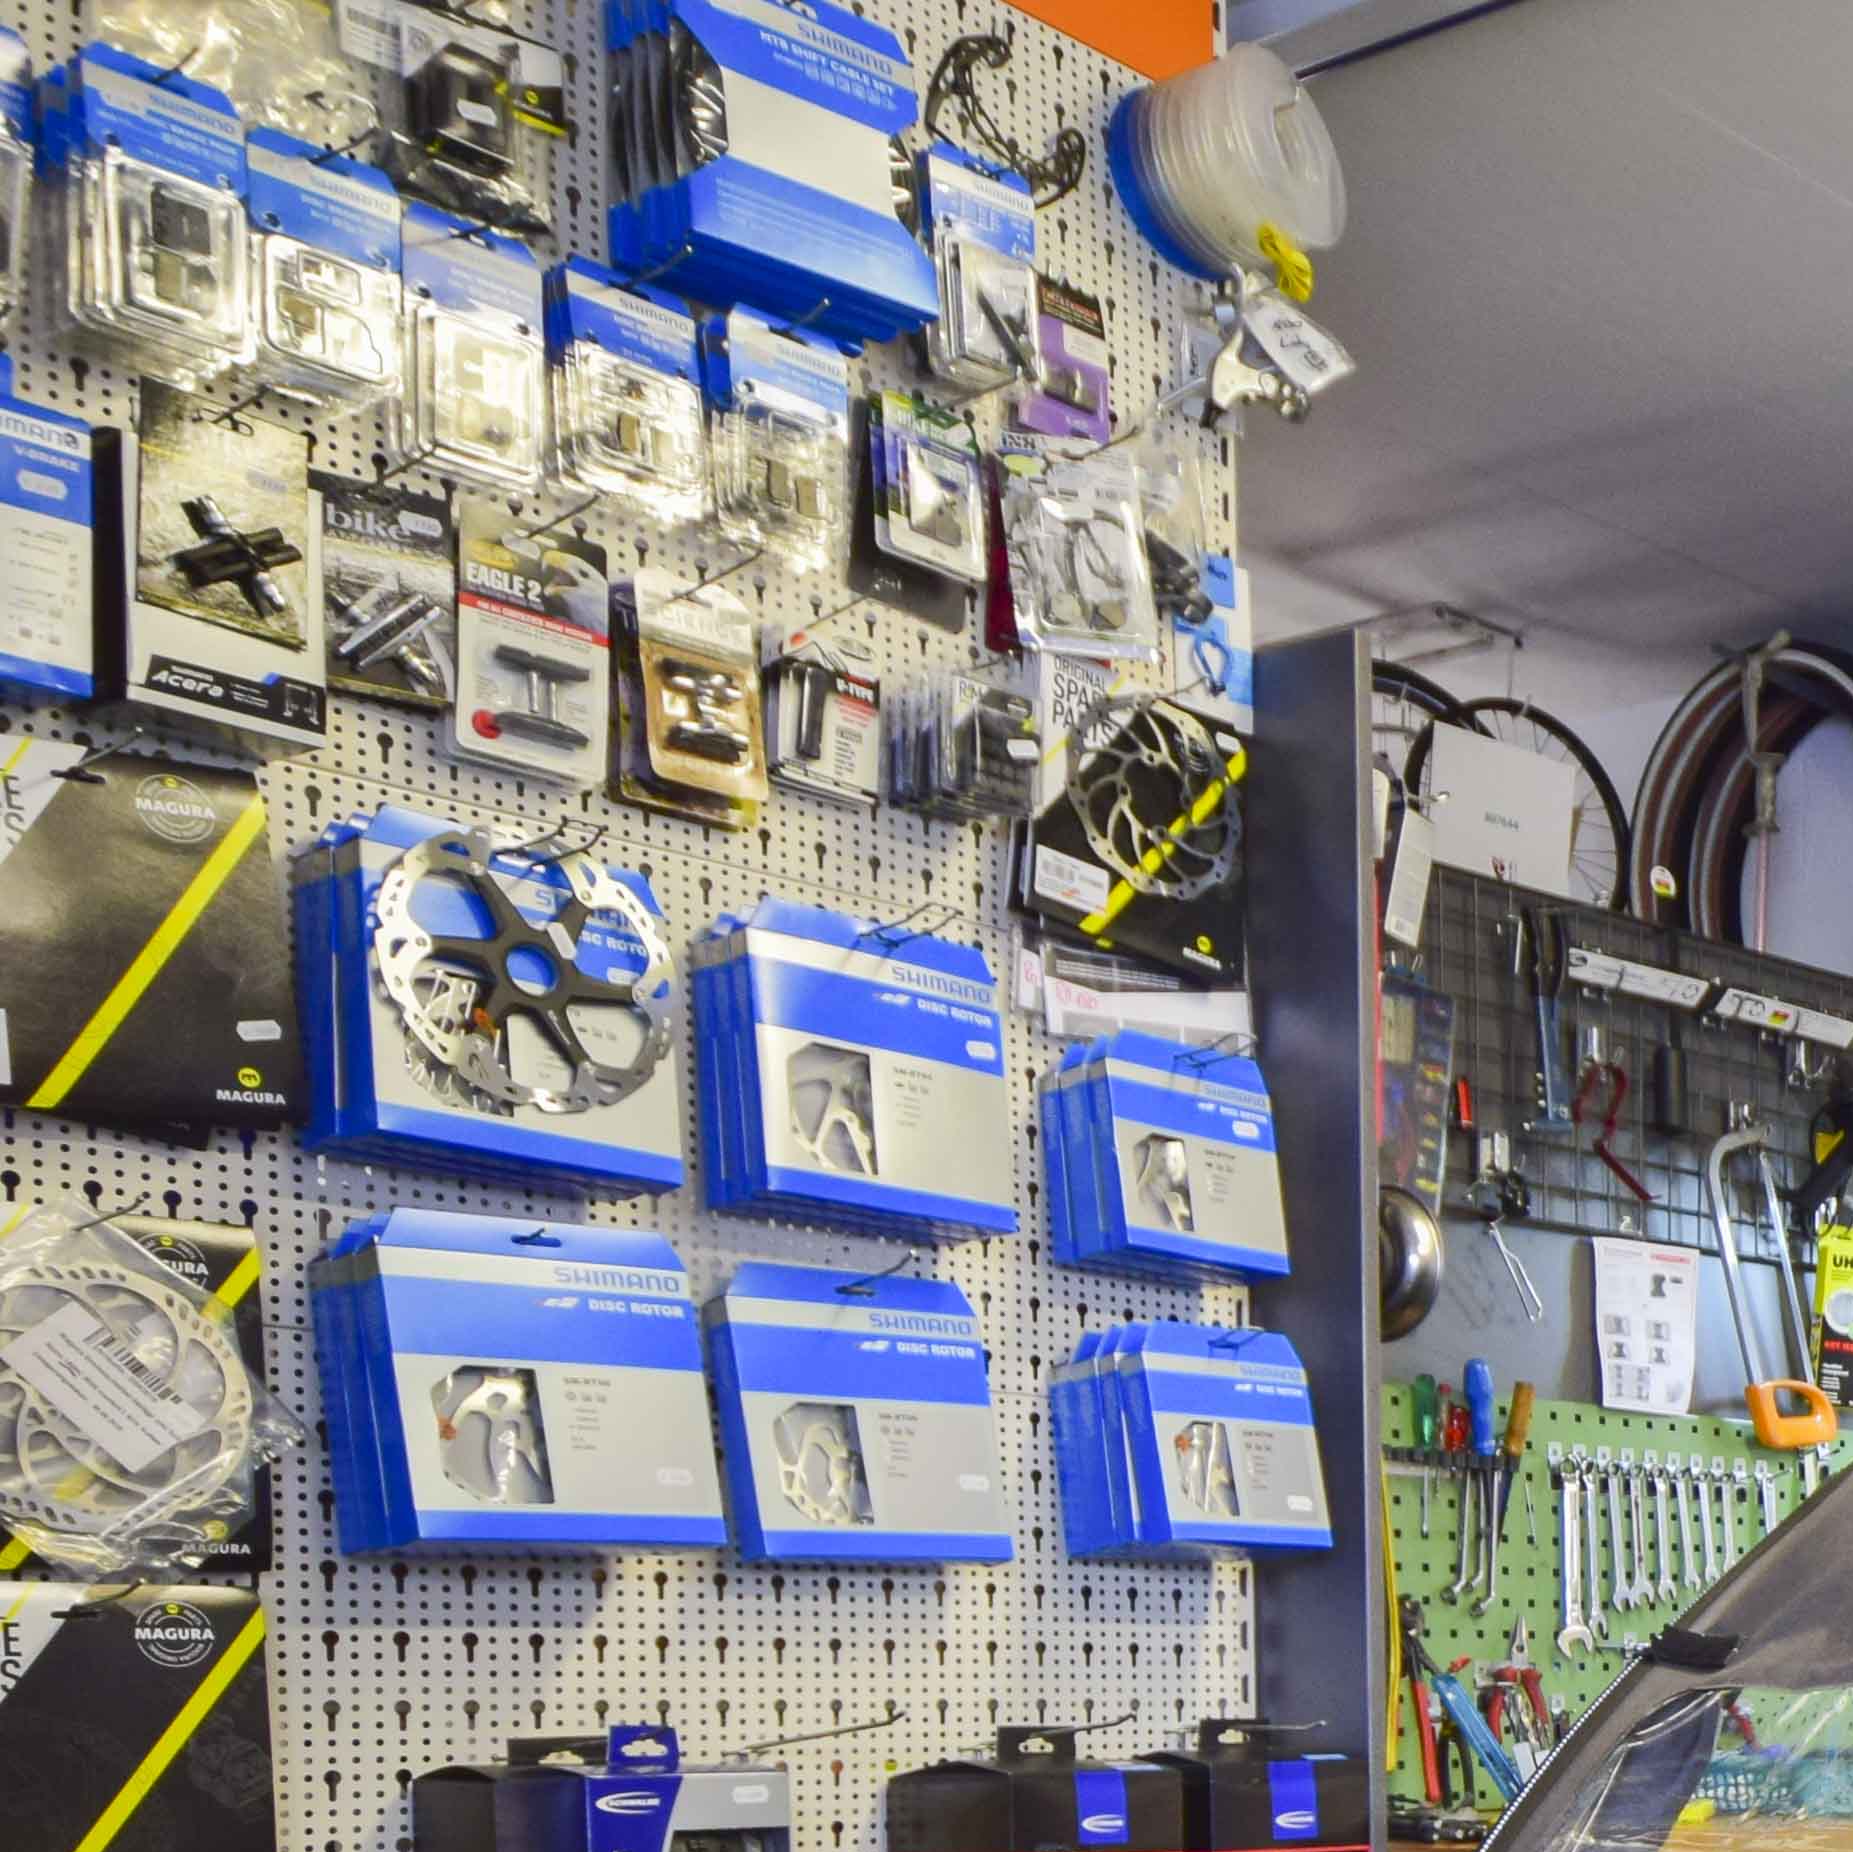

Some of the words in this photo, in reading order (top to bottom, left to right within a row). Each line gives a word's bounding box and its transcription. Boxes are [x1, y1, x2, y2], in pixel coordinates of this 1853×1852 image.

[797, 22, 893, 75] SHIMANO
[466, 562, 525, 599] EAGLE
[526, 582, 543, 602] 2
[136, 796, 216, 820] MAGURA
[891, 966, 992, 1005] SHIMANO
[216, 1089, 287, 1105] MAGURA
[553, 1265, 681, 1295] SHIMANO
[586, 1297, 628, 1314] DISC
[630, 1301, 686, 1319] ROTOR
[868, 1312, 973, 1337] SHIMANO
[896, 1340, 930, 1355] DISC
[931, 1343, 977, 1361] ROTOR
[134, 1625, 216, 1642] MAGURA
